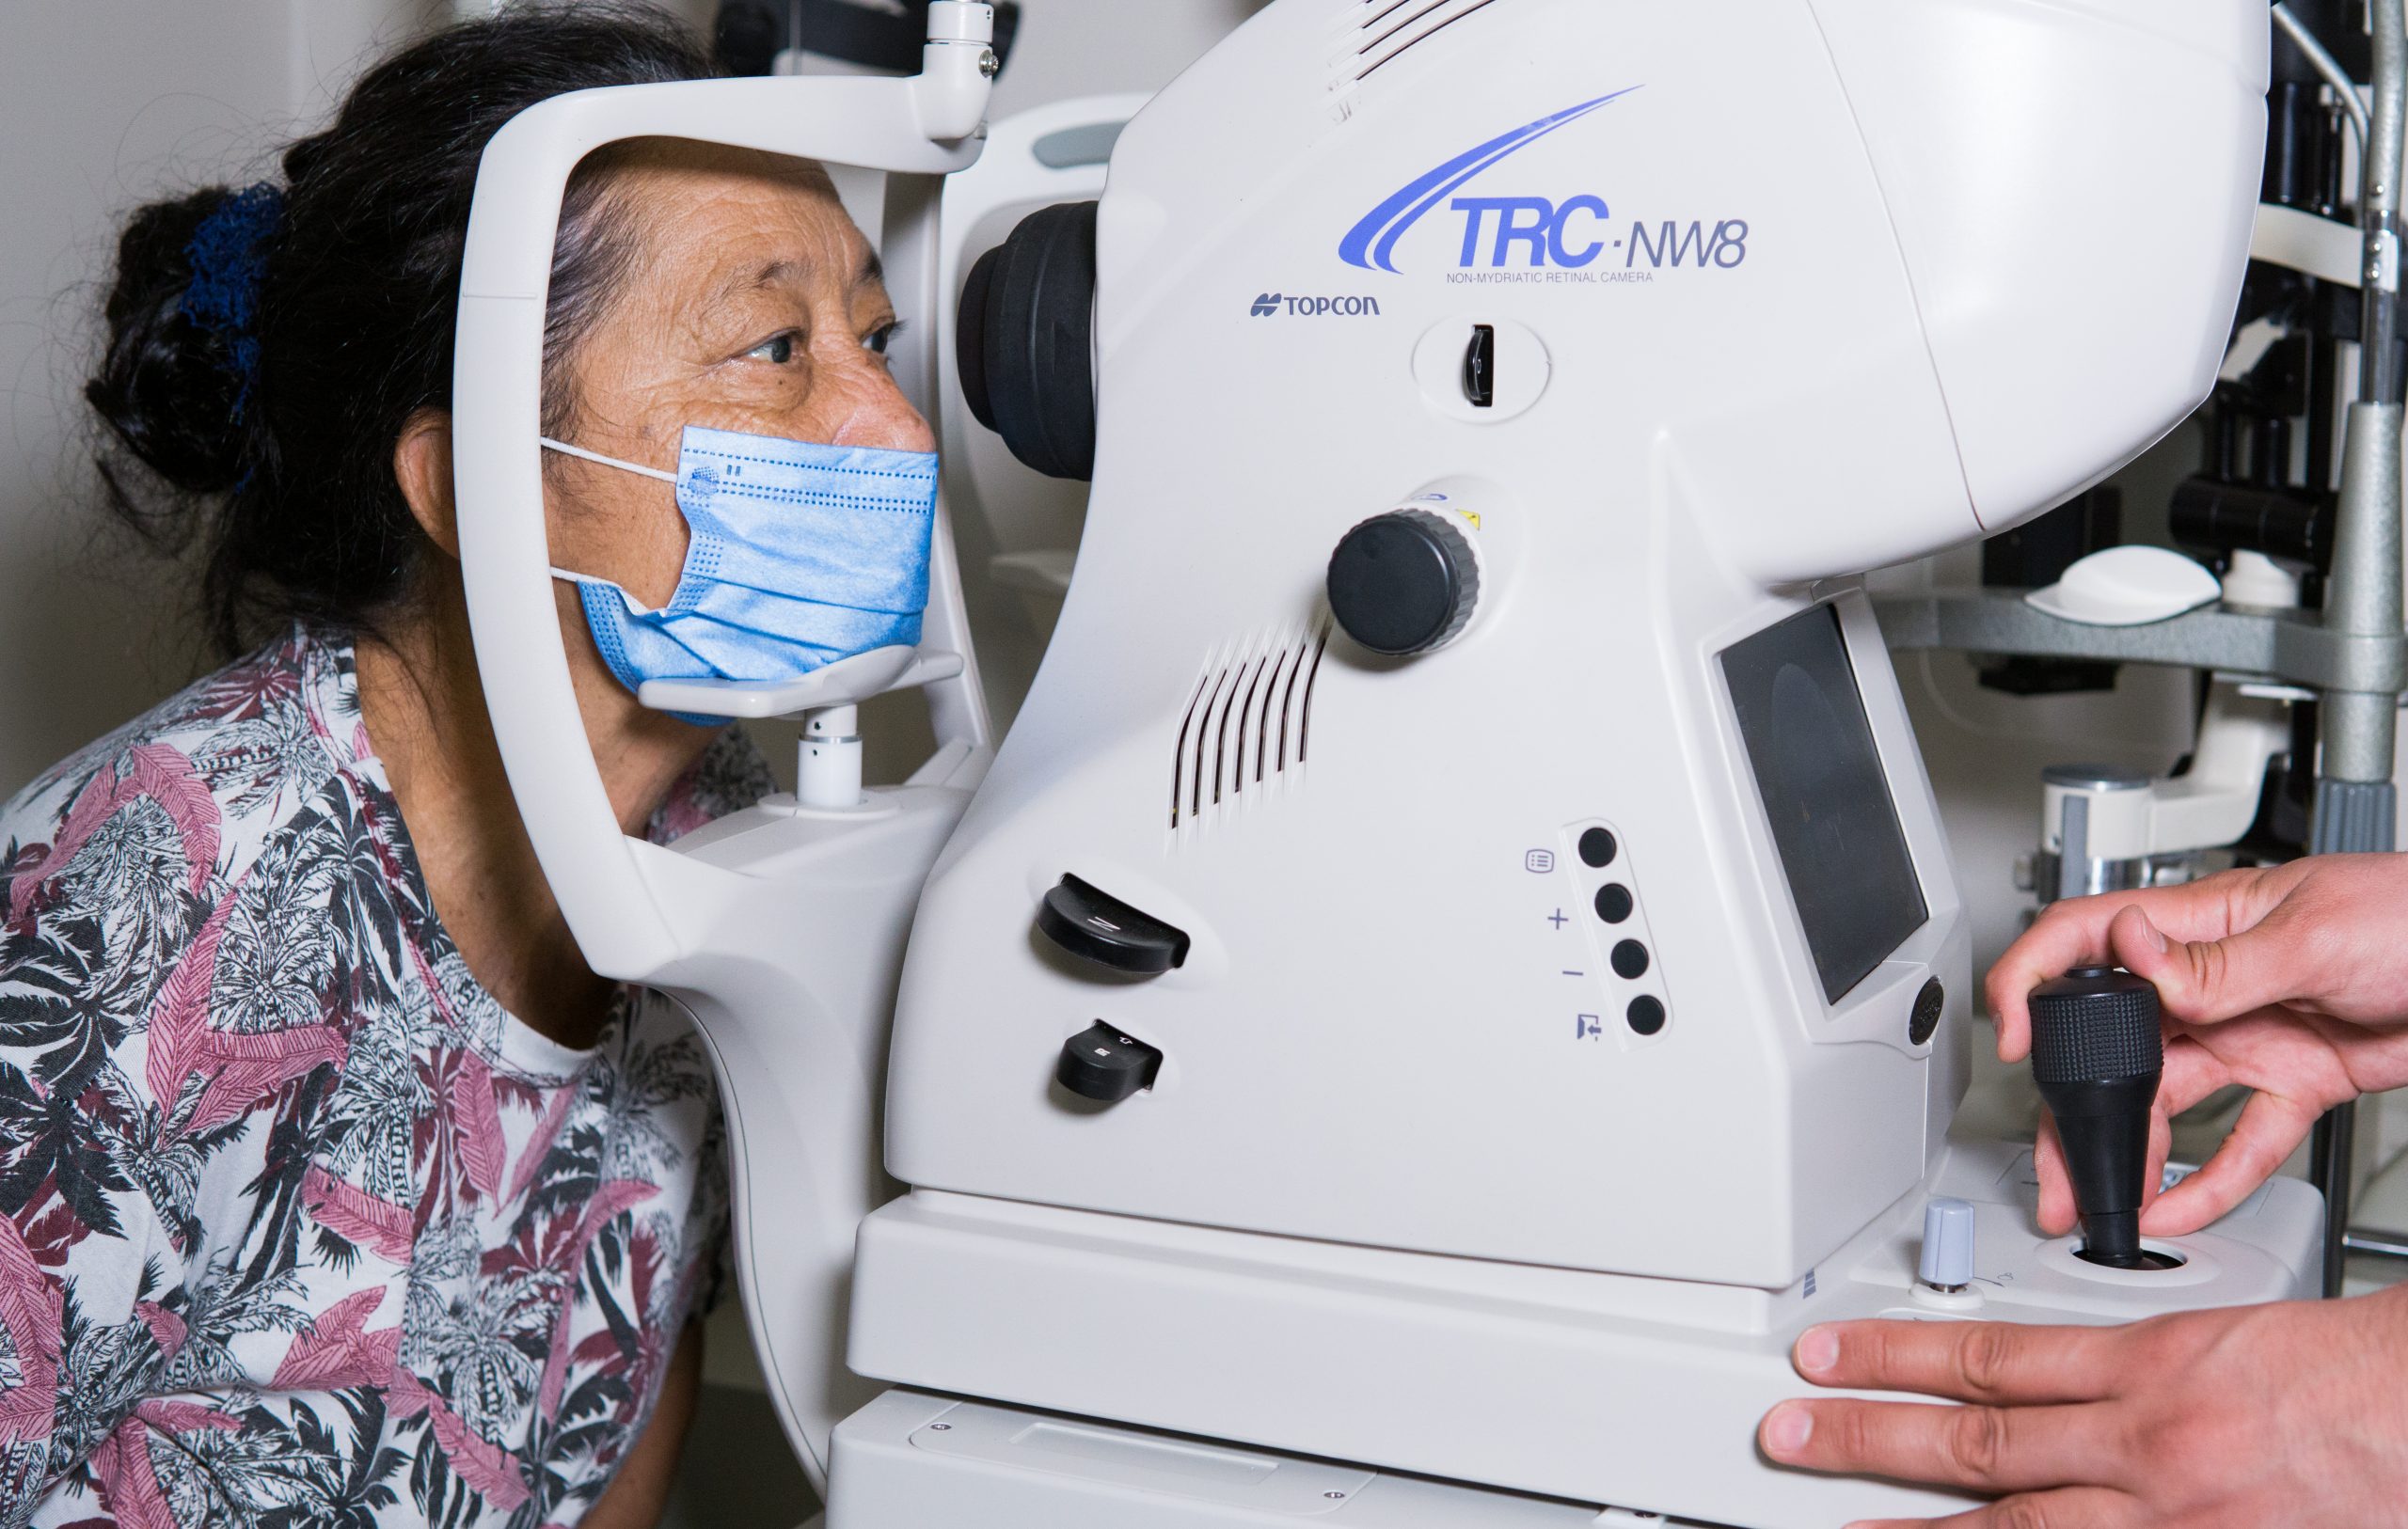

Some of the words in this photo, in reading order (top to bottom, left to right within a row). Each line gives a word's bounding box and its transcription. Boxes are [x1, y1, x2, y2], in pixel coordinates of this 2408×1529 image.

[1446, 272, 1543, 284] NON-MYDRIATIC
[1545, 272, 1597, 283] RETINAL
[1600, 271, 1654, 283] CAMERA
[1283, 295, 1381, 316] TOPCON
